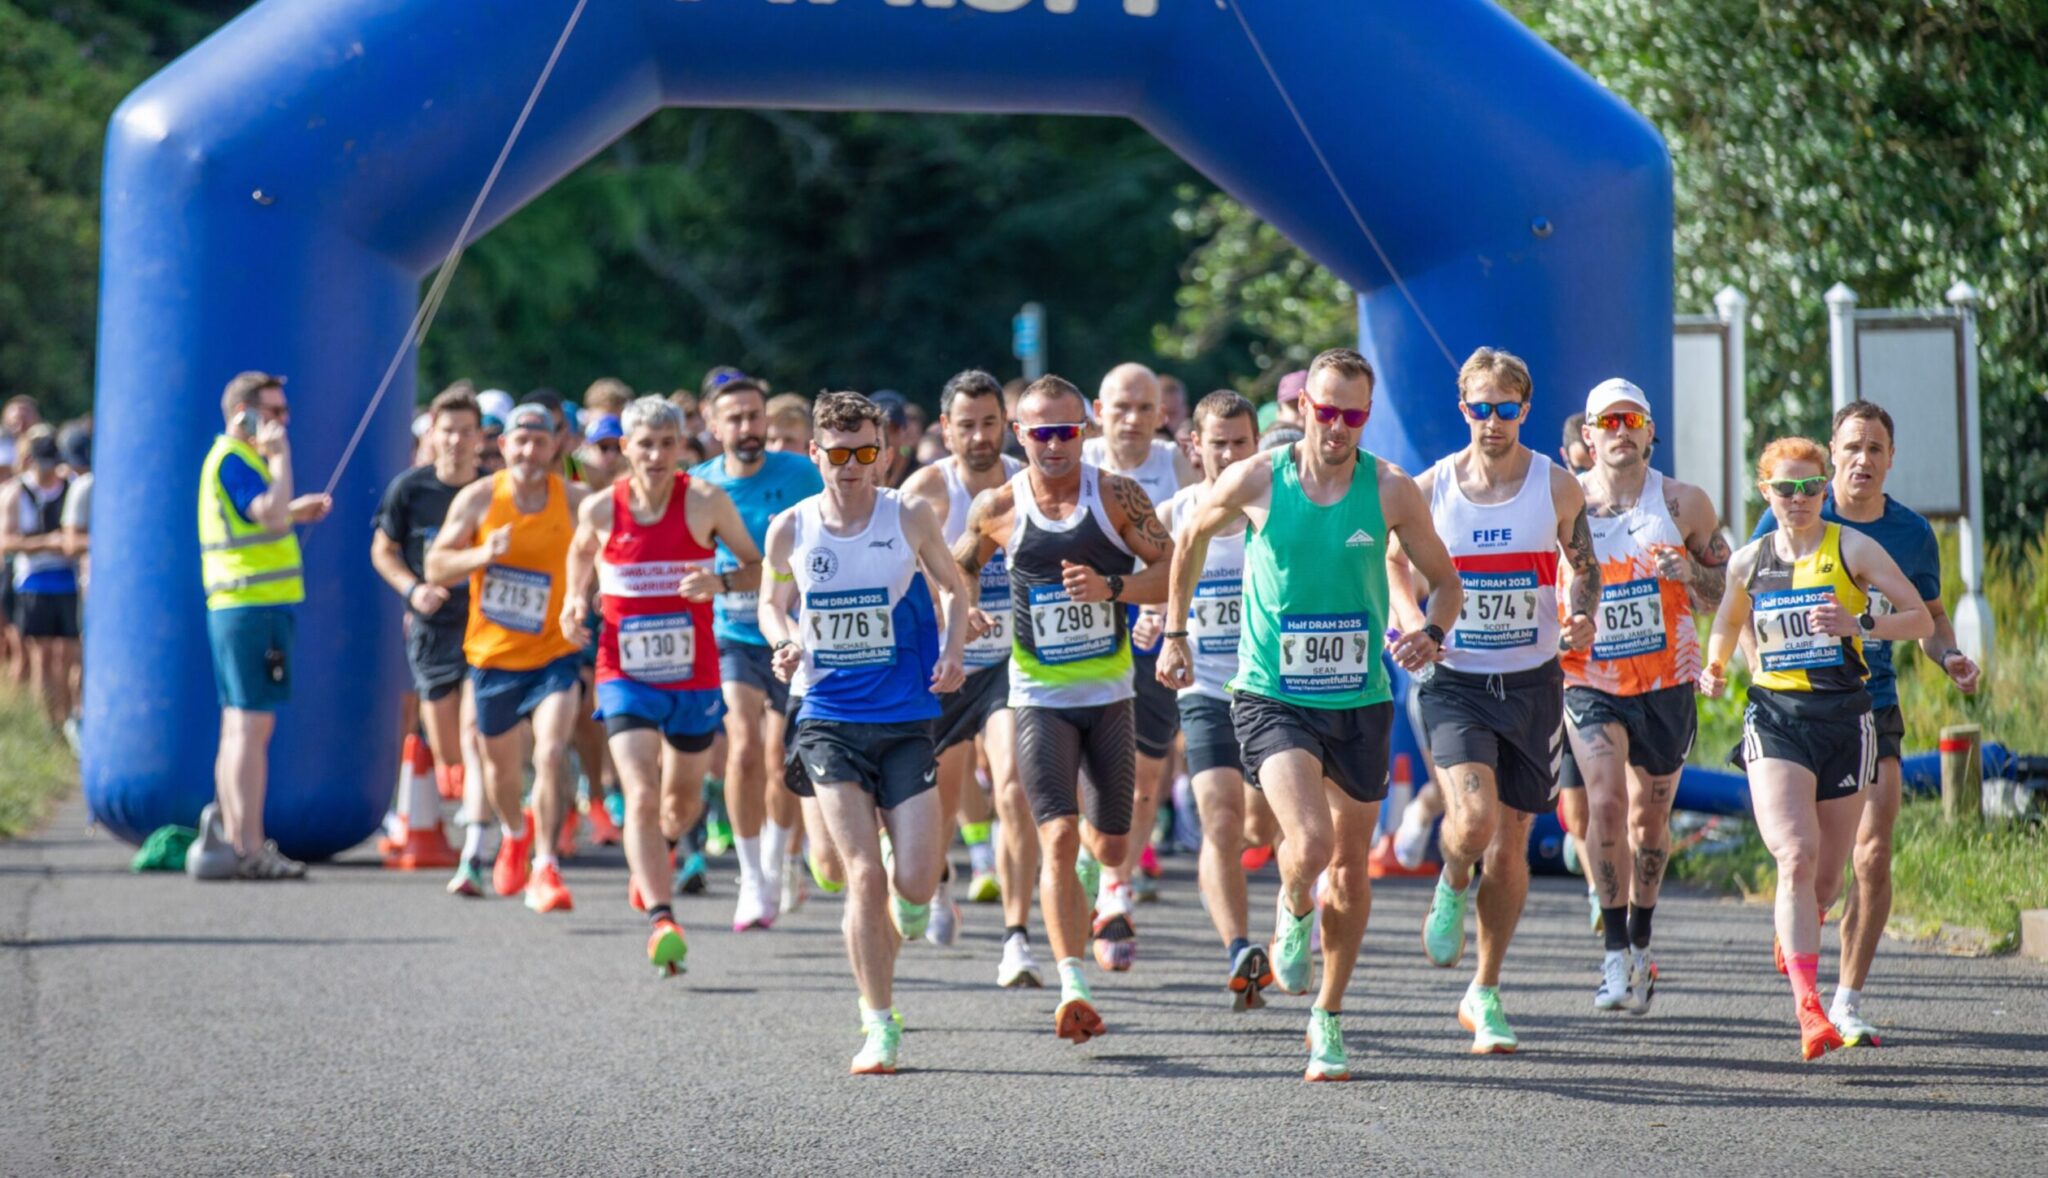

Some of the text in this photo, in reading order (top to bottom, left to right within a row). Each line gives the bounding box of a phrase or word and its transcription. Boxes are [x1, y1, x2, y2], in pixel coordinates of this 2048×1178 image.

[1473, 528, 1512, 542] FIFE
[1462, 577, 1532, 587] Half DRAM 2025
[1035, 591, 1072, 602] Half DR
[1605, 589, 1630, 600] DRAM
[1631, 585, 1654, 596] 2025
[811, 594, 884, 607] Half DRAM 2025
[1777, 595, 1804, 606] DRAM
[1805, 593, 1827, 603] 202
[1478, 594, 1516, 621] 574
[1054, 603, 1094, 633] 298
[1604, 602, 1643, 630] 625
[828, 612, 870, 640] 776
[1287, 619, 1362, 630] Half DRAM 2025
[1483, 623, 1512, 632] SCOTT
[1460, 629, 1534, 641] www.eventfull.biz
[1600, 629, 1654, 642] LEWIS JAMES
[642, 633, 675, 658] 130
[833, 642, 871, 650] MICHAEL
[1305, 636, 1344, 663] 940
[1594, 637, 1663, 654] www.eventfull.biz
[1784, 640, 1815, 650] CLAIRE
[817, 647, 892, 660] www.eventfull.biz
[1764, 648, 1838, 663] www.eventfull.biz
[1312, 666, 1337, 675] SEAN
[1285, 675, 1363, 686] www.eventfull.biz
